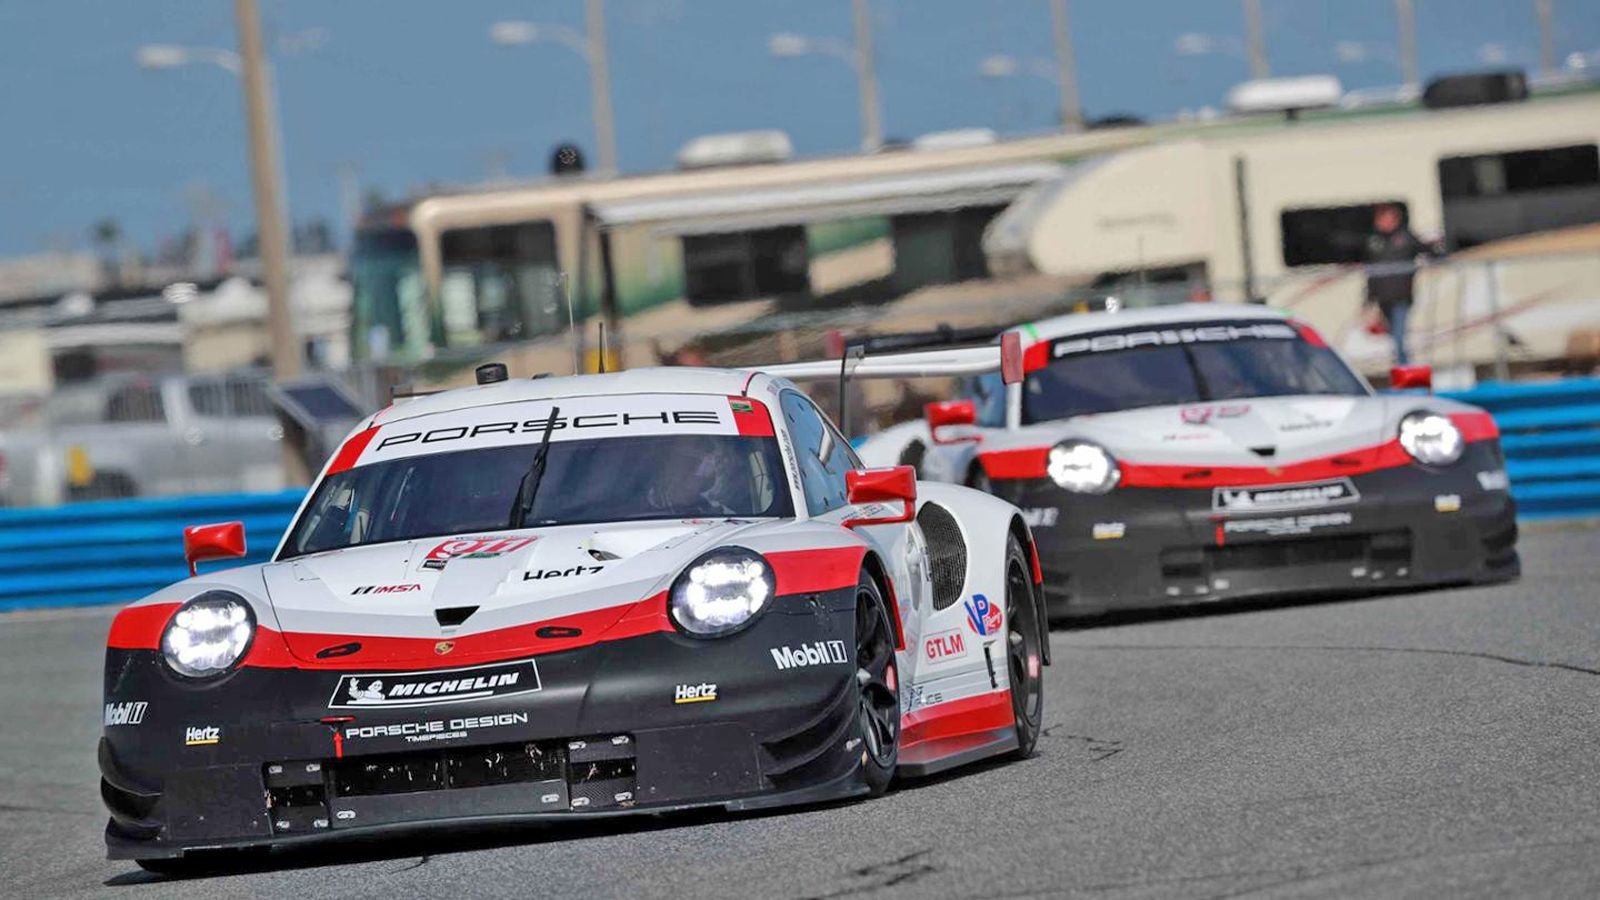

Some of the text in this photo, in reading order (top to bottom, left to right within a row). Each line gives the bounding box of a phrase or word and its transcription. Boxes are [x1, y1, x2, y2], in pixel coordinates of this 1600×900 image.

[376, 410, 721, 451] PORSCHE
[523, 565, 604, 582] Hertz
[372, 583, 421, 595] IMSA
[964, 593, 999, 636] VP
[770, 642, 831, 670] Mobil
[926, 633, 965, 660] GTLM
[388, 672, 520, 697] MICHELIN
[675, 683, 717, 699] Hertz
[185, 725, 220, 742] Hertz
[346, 712, 528, 739] PORSCHE DESIGN
